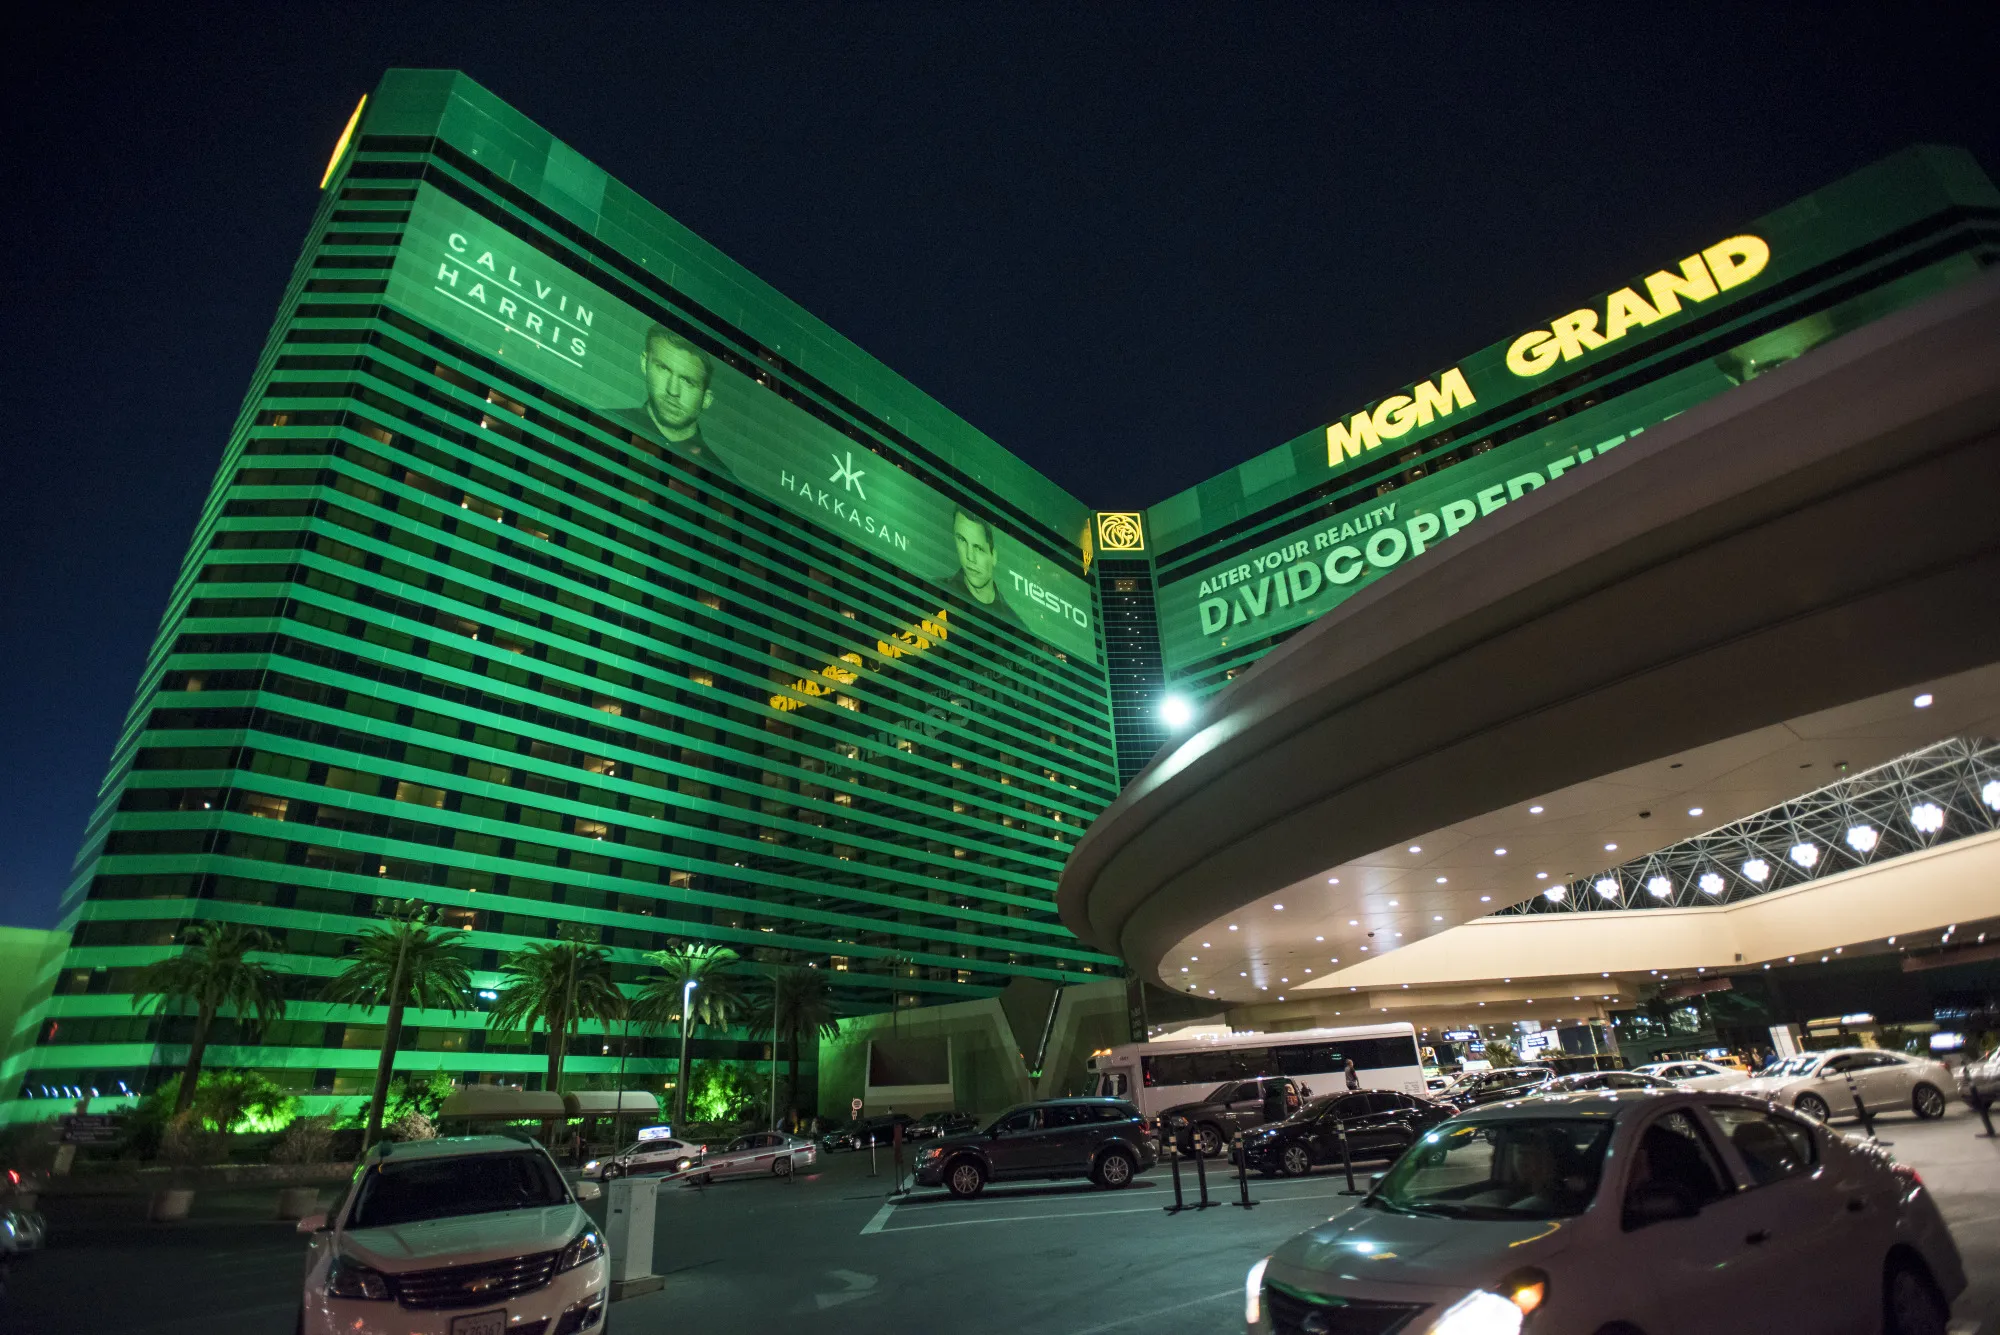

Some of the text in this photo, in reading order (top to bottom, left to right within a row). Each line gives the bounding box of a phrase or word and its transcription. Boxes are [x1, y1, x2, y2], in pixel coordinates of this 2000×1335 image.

[437, 262, 586, 357] HARRIS
[448, 233, 593, 327] CALVIN
[1326, 235, 1770, 468] MGM GRAND
[781, 470, 906, 551] HAKKASAN
[1199, 502, 1396, 598] ALTER YOUR REALITY
